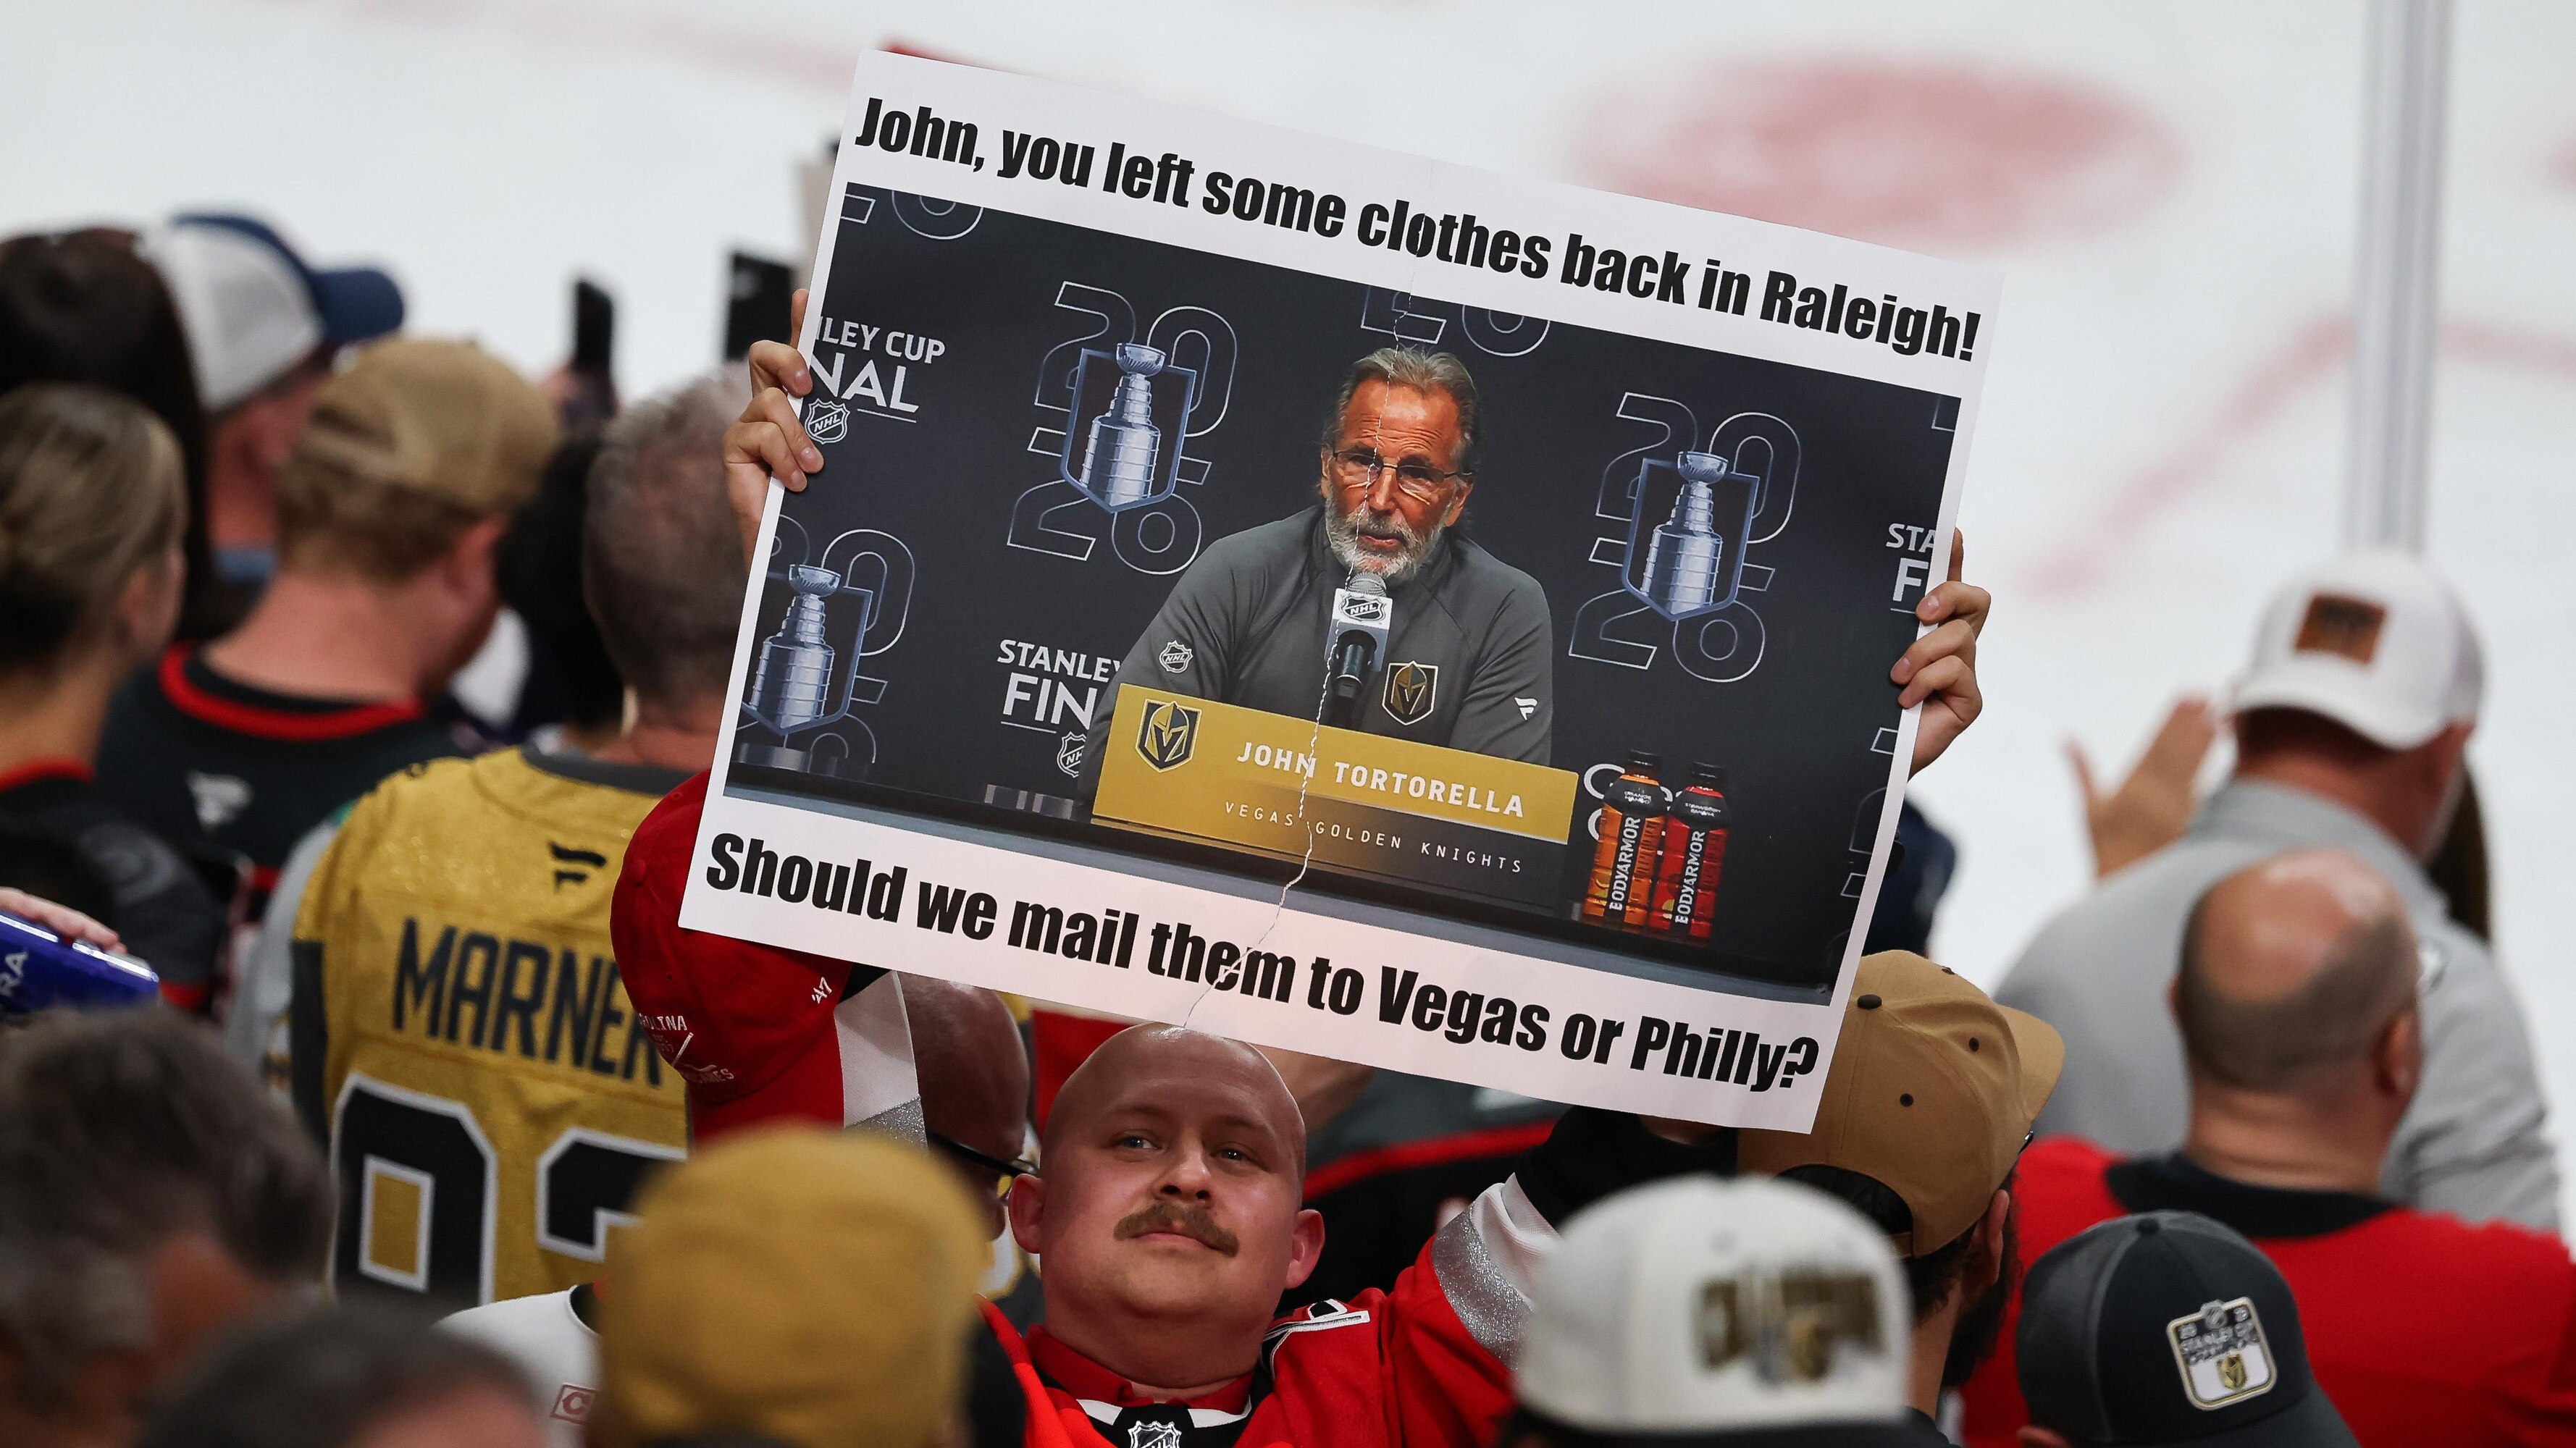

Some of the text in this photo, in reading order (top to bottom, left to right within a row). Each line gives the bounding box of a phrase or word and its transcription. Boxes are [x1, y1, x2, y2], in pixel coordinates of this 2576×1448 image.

[855, 97, 1981, 362] John, you left some clothes back in Raleigh!
[885, 331, 946, 364] CUP
[813, 413, 841, 433] NHL
[1350, 602, 1378, 615] NHL
[1002, 672, 1098, 731] FIN
[1237, 741, 1524, 818] JOHN TORTORELLA
[1225, 801, 1522, 873] VEGAS GOLDEN KNIGHTS
[1608, 816, 1641, 912] BODYARMOR
[1674, 830, 1706, 925] BODYARMOR
[706, 833, 1819, 1093] Should we mail them to Vegas or Philly?
